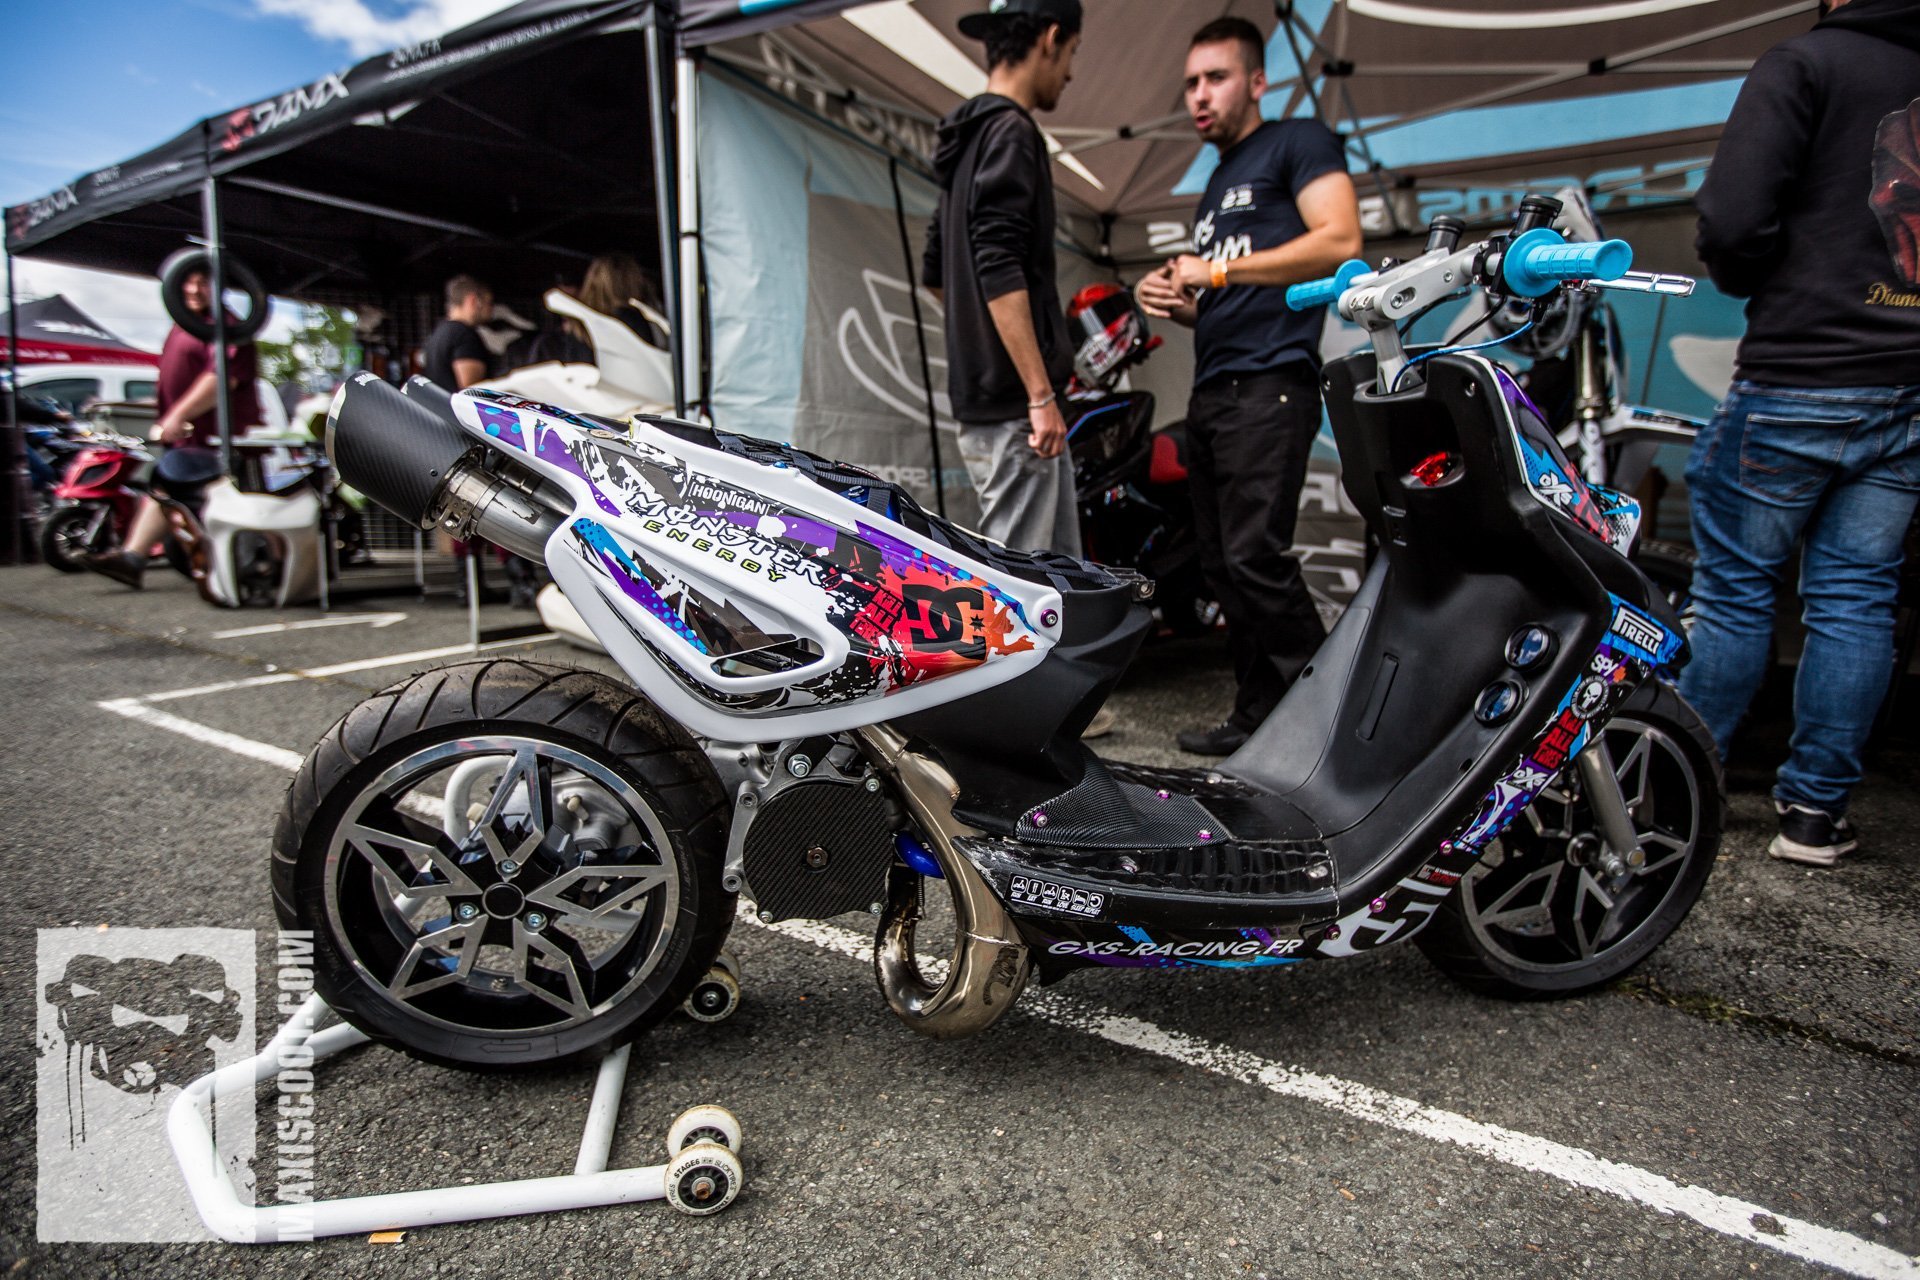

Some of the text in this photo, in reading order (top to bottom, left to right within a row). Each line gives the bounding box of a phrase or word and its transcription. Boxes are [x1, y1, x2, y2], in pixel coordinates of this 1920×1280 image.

[643, 519, 787, 582] ENERGY
[864, 602, 895, 633] ALL
[1611, 605, 1664, 655] PIRELLI
[1591, 653, 1619, 677] SPY
[1540, 726, 1574, 753] ALL
[1048, 939, 1304, 957] GXS-RACING.FR
[673, 1158, 701, 1179] STAGE6
